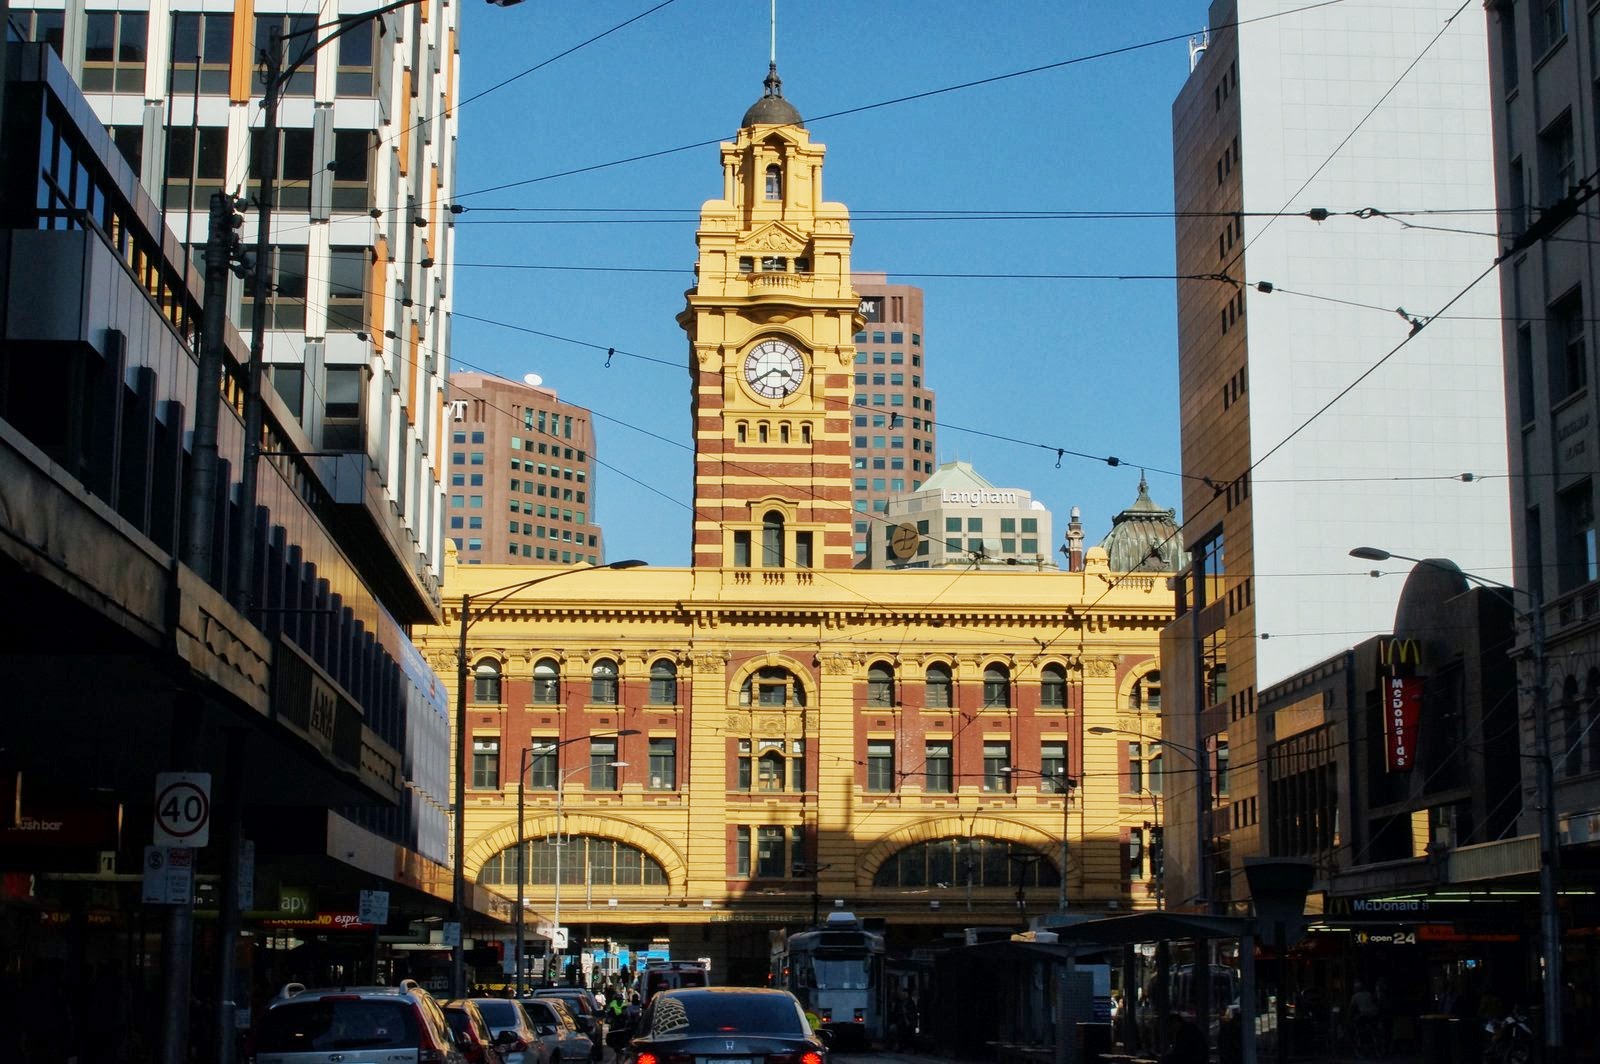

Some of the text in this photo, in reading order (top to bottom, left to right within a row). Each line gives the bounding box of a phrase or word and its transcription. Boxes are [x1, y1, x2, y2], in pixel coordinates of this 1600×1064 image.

[942, 488, 1016, 507] Langham
[1391, 679, 1408, 767] McDonald's
[161, 796, 202, 822] 40
[1353, 900, 1430, 912] McDonalds
[1370, 931, 1416, 946] open 24
